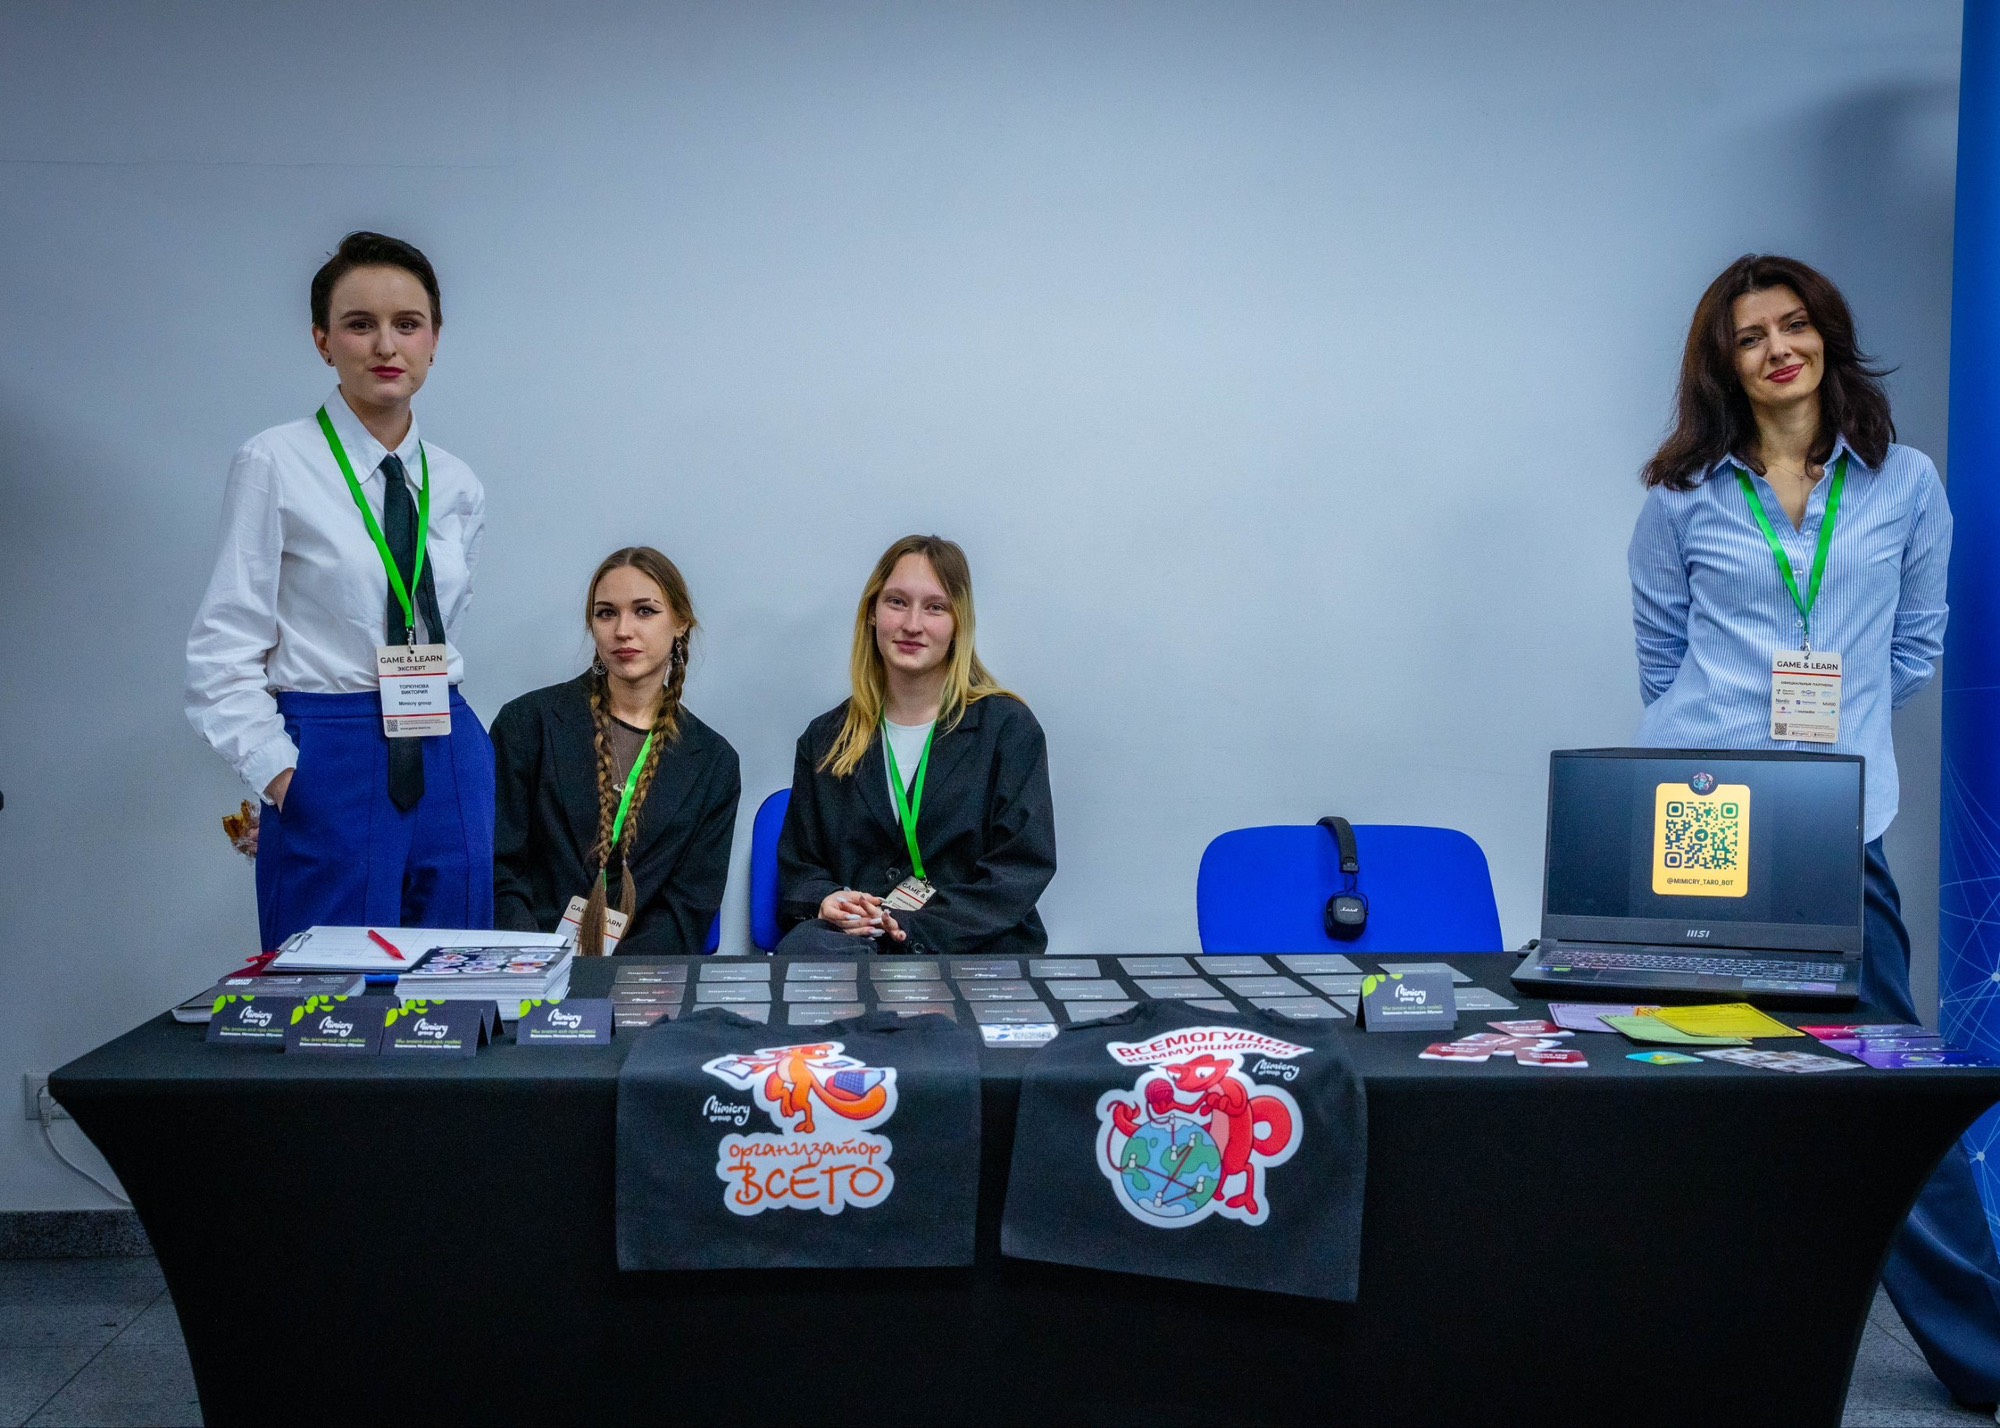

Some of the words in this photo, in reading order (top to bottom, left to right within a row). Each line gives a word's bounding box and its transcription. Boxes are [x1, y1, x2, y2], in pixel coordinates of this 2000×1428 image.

[380, 656, 405, 664] GAME
[414, 655, 443, 663] LEARN
[1776, 660, 1802, 669] GAME
[1811, 662, 1839, 671] LEARN
[1666, 877, 1734, 887] @MIMICRY_TARO_BOT
[570, 904, 585, 914] GA
[606, 918, 622, 928] ARN
[1116, 1031, 1302, 1057] ВСЕМОГУЩИЙ
[1127, 1043, 1289, 1062] коммуникатор
[1252, 1058, 1300, 1081] Mimicry
[702, 1095, 750, 1126] Mimicry
[729, 1138, 882, 1168] организатор
